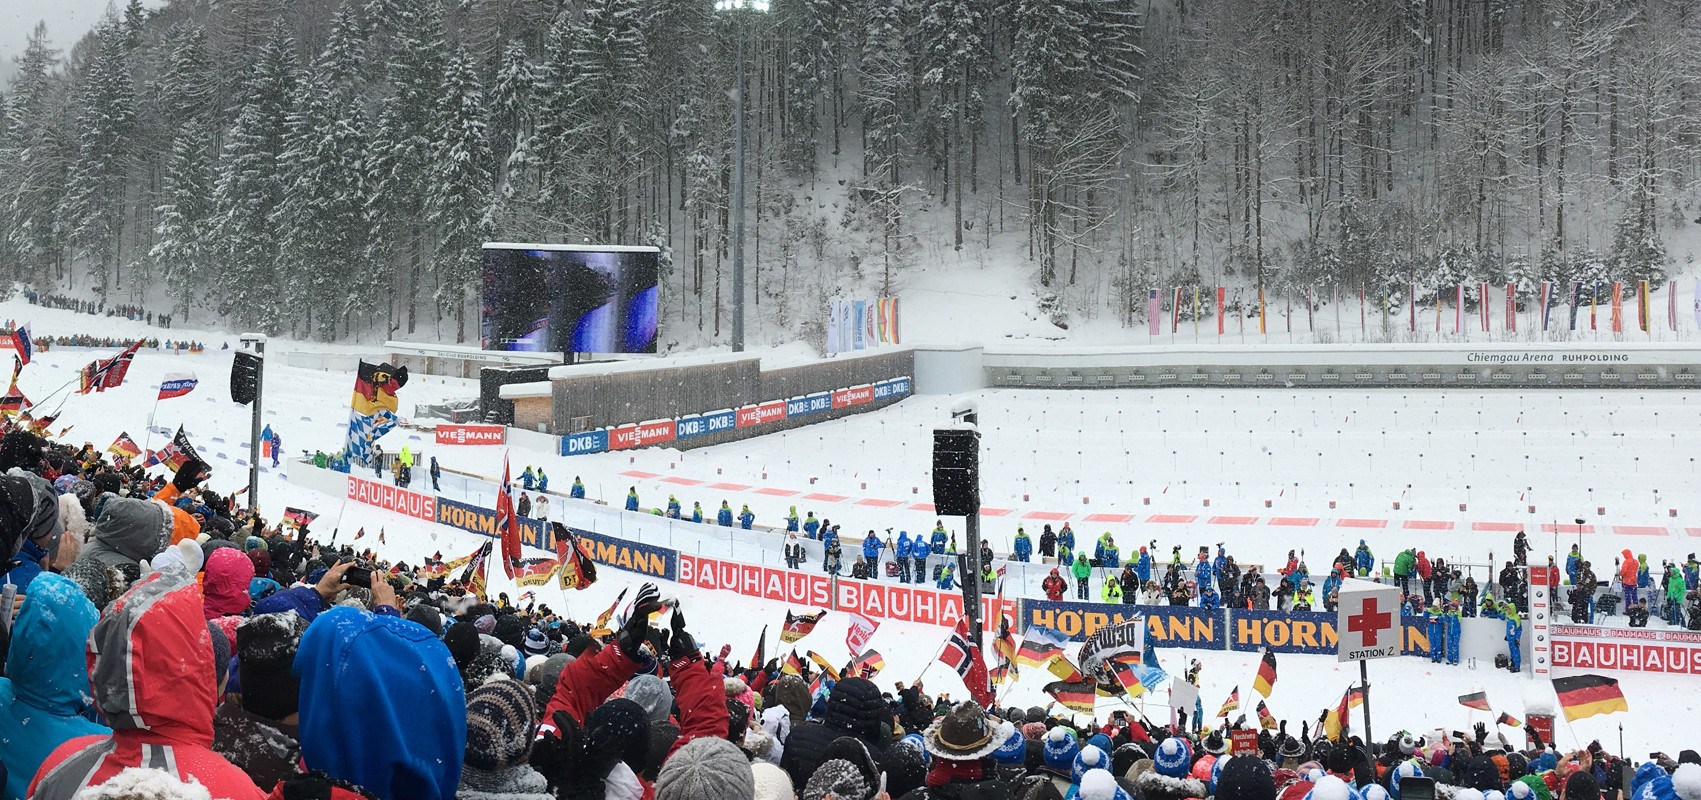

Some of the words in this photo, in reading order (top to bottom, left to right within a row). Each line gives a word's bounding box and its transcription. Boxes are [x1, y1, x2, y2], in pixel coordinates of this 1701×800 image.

[1467, 352, 1520, 363] Chiemgau
[1522, 353, 1554, 362] Arena
[1562, 354, 1629, 362] RUHPOLDING
[874, 385, 888, 398] DKB
[892, 382, 905, 393] DKB
[788, 402, 804, 415] DKB
[811, 398, 825, 410] DKB
[709, 415, 728, 431] DKB
[741, 407, 782, 424] VIESSMANN
[437, 428, 501, 443] VIESSMANN
[617, 426, 669, 446] VIESSMANN
[678, 421, 699, 436] DKB
[569, 436, 592, 452] DKB
[349, 478, 434, 518] BAUHAUS
[441, 503, 537, 545] HÖRMN
[679, 558, 830, 603] BAUHAUS
[839, 585, 1013, 629] BAUHAS
[1032, 608, 1214, 642] HÖRANN
[1557, 627, 1601, 637] BAUHAUS
[1238, 617, 1431, 653] HÖRMN
[1611, 630, 1656, 639] BAUHAUS
[1349, 649, 1385, 660] STATION
[1387, 646, 1395, 656] 2
